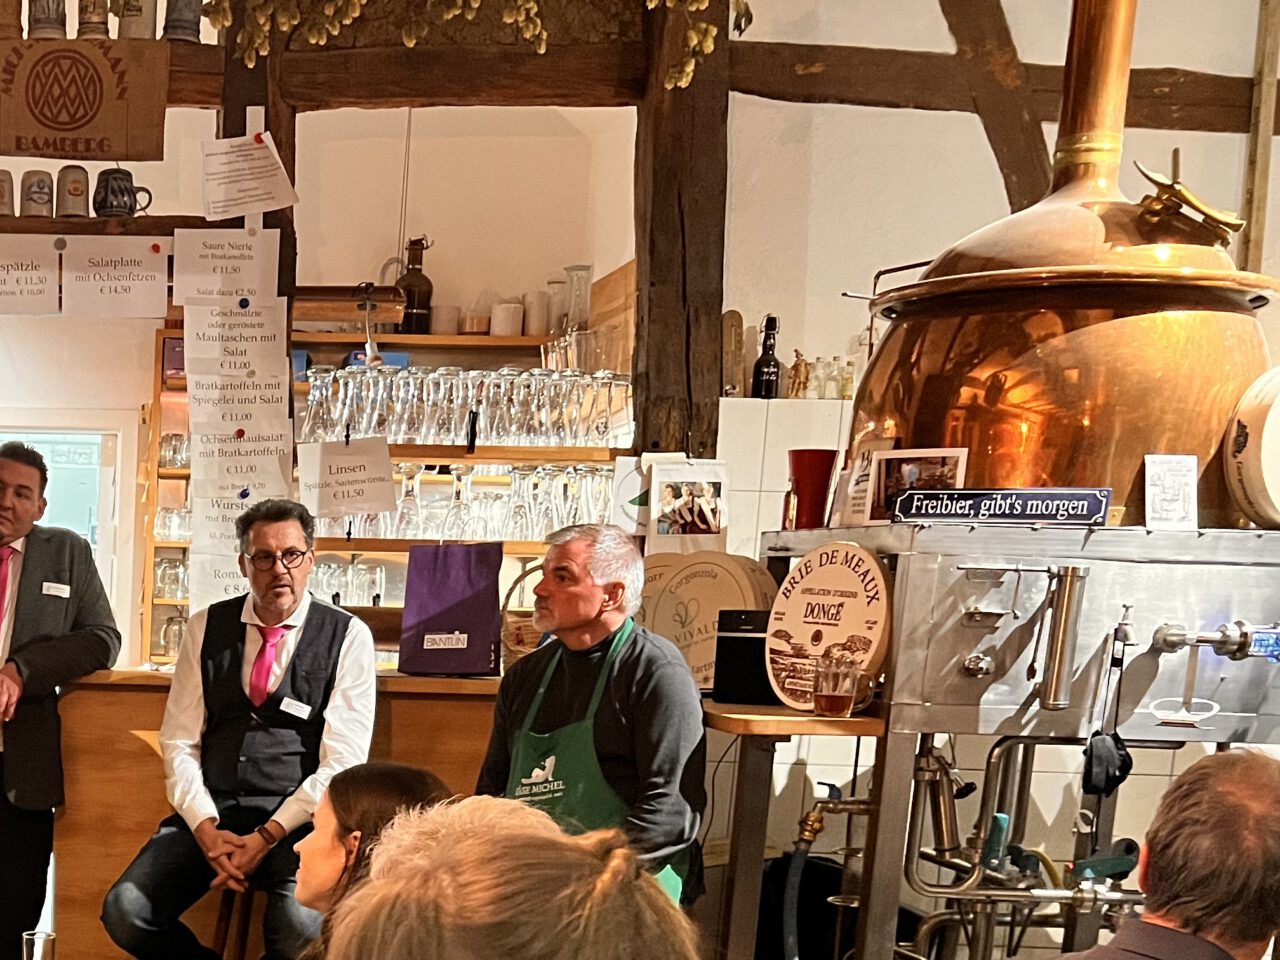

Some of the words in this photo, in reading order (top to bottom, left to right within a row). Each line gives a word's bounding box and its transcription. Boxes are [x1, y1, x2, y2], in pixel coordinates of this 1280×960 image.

[15, 135, 113, 153] BAMBERG
[202, 241, 226, 250] Saure
[87, 257, 143, 270] Salatplatte
[75, 273, 91, 283] mit
[93, 272, 156, 283] Ochsenfetzen
[108, 285, 131, 296] 14,50
[210, 309, 263, 318] Geschmälzte
[207, 321, 226, 329] oder
[228, 321, 265, 330] geröstete
[195, 332, 258, 343] Maultaschen
[260, 332, 277, 343] mit
[223, 346, 247, 357] Salat
[228, 360, 251, 370] 11,00
[195, 380, 261, 391] Bratkartoffeln
[264, 381, 281, 391] mit
[193, 394, 235, 407] Spiegelei
[237, 394, 257, 404] und
[259, 394, 283, 404] Salat
[230, 412, 252, 421] 11,00
[199, 450, 215, 458] mit
[217, 446, 286, 458] Bratkartoffeln
[234, 465, 257, 475] 11,00
[328, 464, 366, 475] Linsen
[341, 488, 364, 499] 11,50
[910, 494, 974, 517] Freibier,
[979, 493, 1022, 520] gibt's
[1025, 499, 1089, 520] morgen
[205, 514, 220, 523] mit
[222, 513, 237, 523] Bro
[668, 569, 718, 595] Gorgonzola
[781, 559, 814, 601] BRIE
[818, 549, 840, 568] DE
[840, 550, 881, 607] MEAUX
[425, 637, 466, 648] BANTLIN
[531, 780, 566, 794] MICHEL
